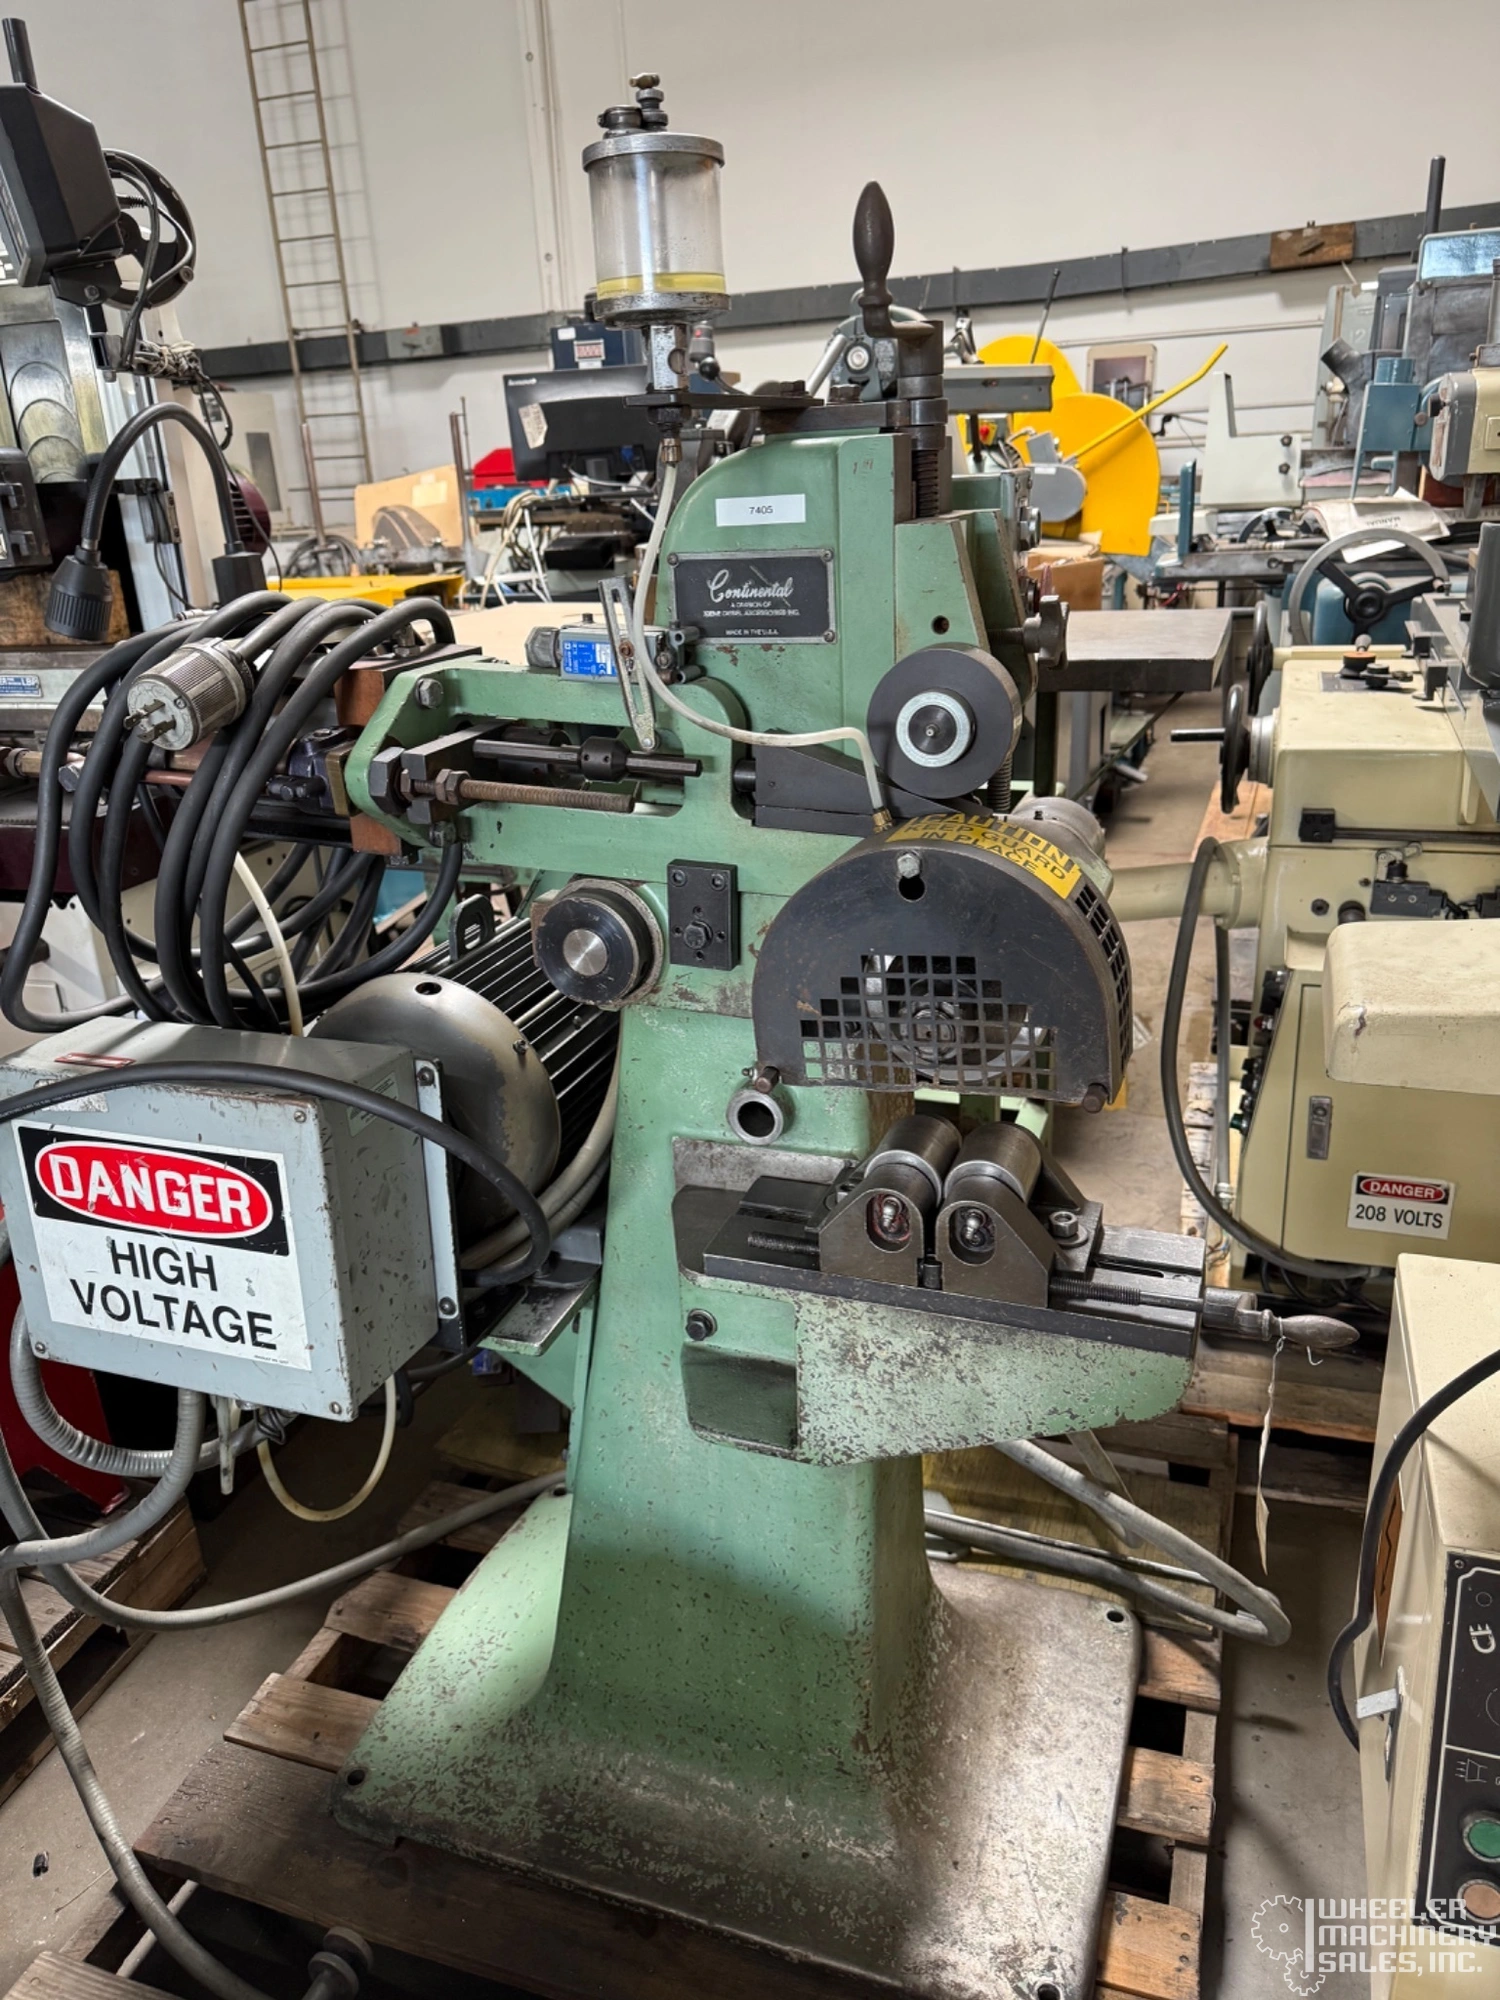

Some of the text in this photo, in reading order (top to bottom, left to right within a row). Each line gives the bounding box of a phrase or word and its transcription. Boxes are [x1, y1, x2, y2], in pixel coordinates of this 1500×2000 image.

[749, 505, 773, 515] 7405
[707, 569, 794, 603] Continental
[904, 823, 1066, 880] KEEP GUARD
[920, 813, 1070, 869] CAUTION
[921, 831, 1038, 874] IN PLACE
[48, 1153, 253, 1227] DANGER
[1370, 1181, 1435, 1199] DANGER
[1355, 1204, 1443, 1229] 208 VOLTS
[110, 1239, 218, 1291] HIGH
[69, 1278, 277, 1350] VOLTAGE
